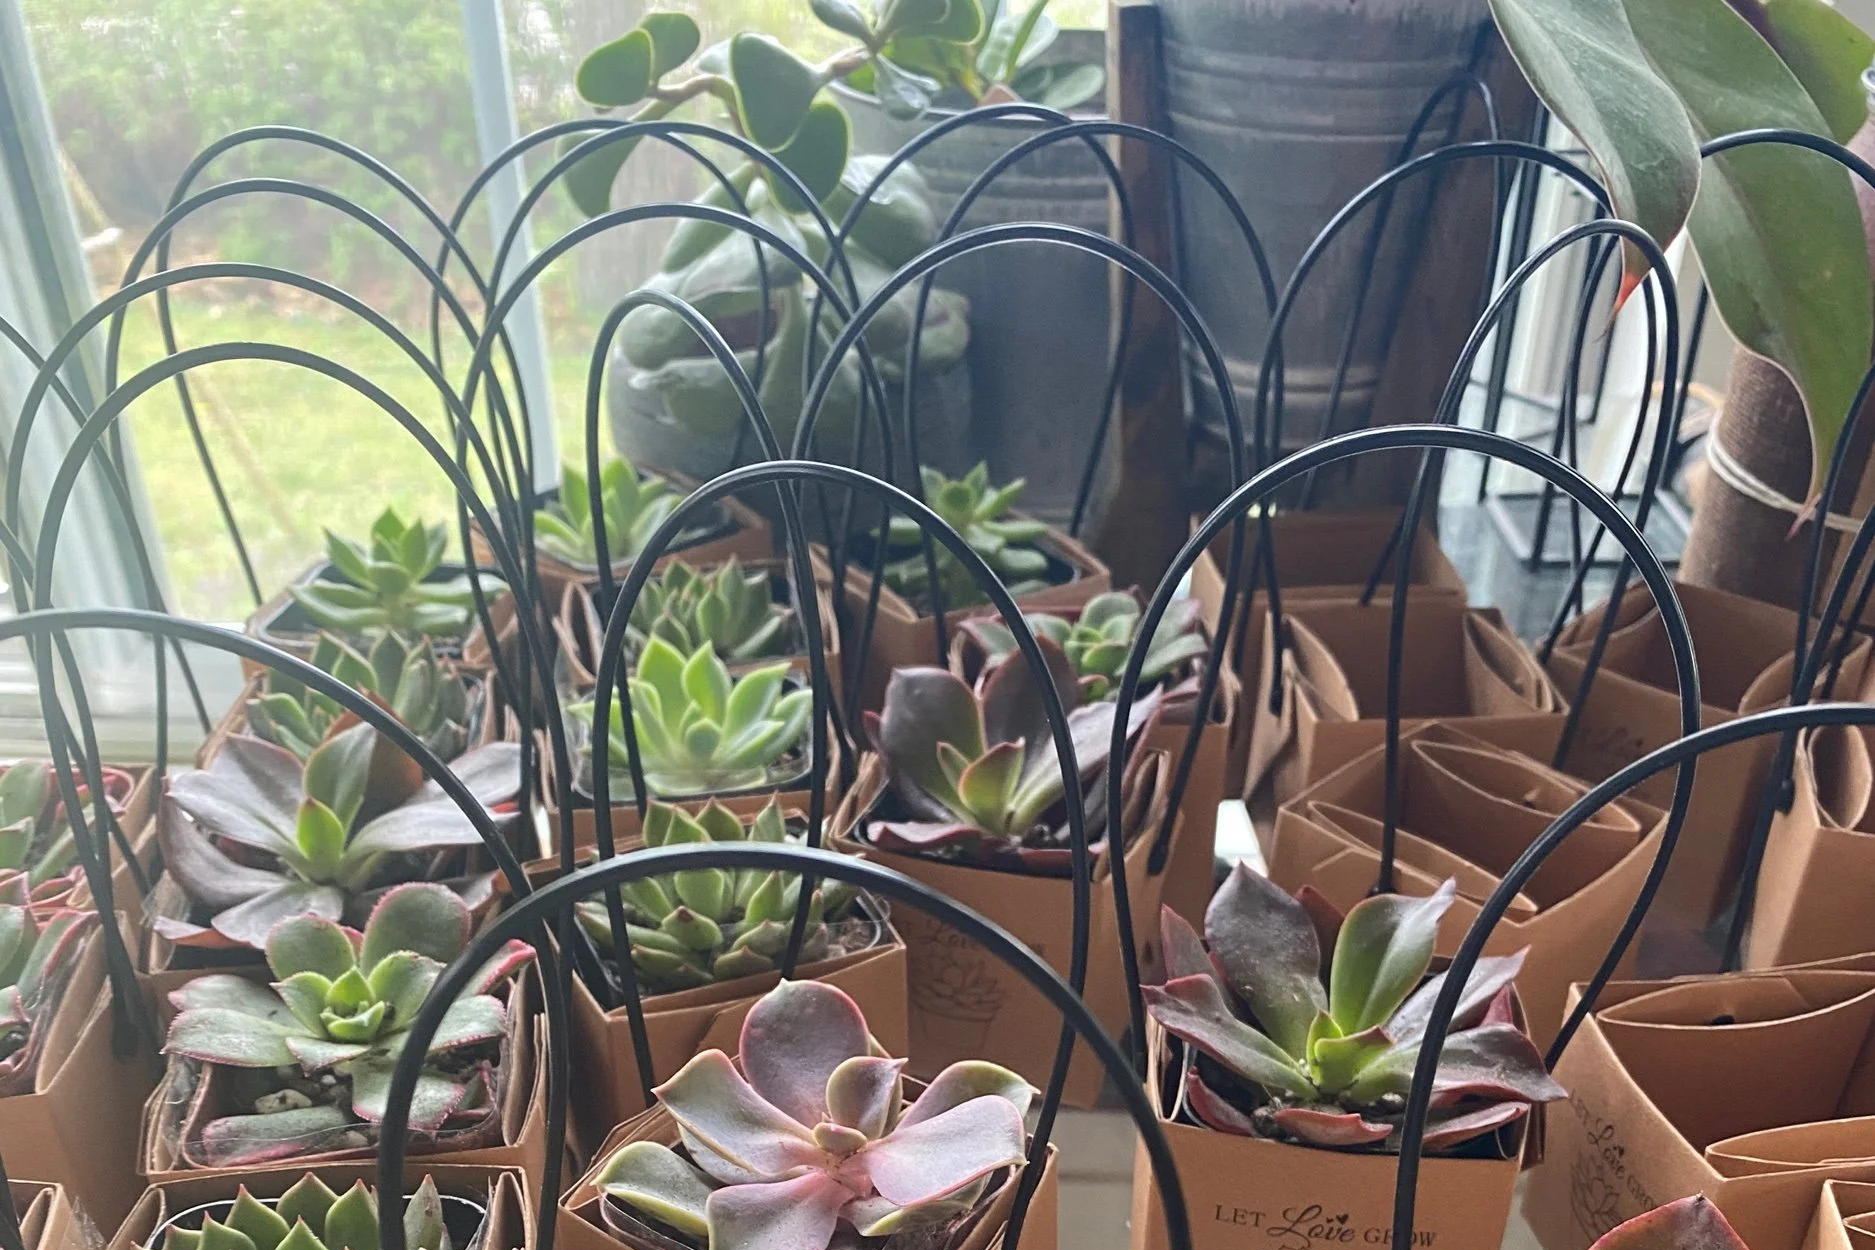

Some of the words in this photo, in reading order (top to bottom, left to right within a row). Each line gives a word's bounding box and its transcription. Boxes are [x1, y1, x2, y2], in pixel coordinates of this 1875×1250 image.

[1587, 1118, 1626, 1179] Love
[1627, 1174, 1658, 1212] GRO
[1214, 1204, 1266, 1228] LET
[1266, 1204, 1356, 1249] Love
